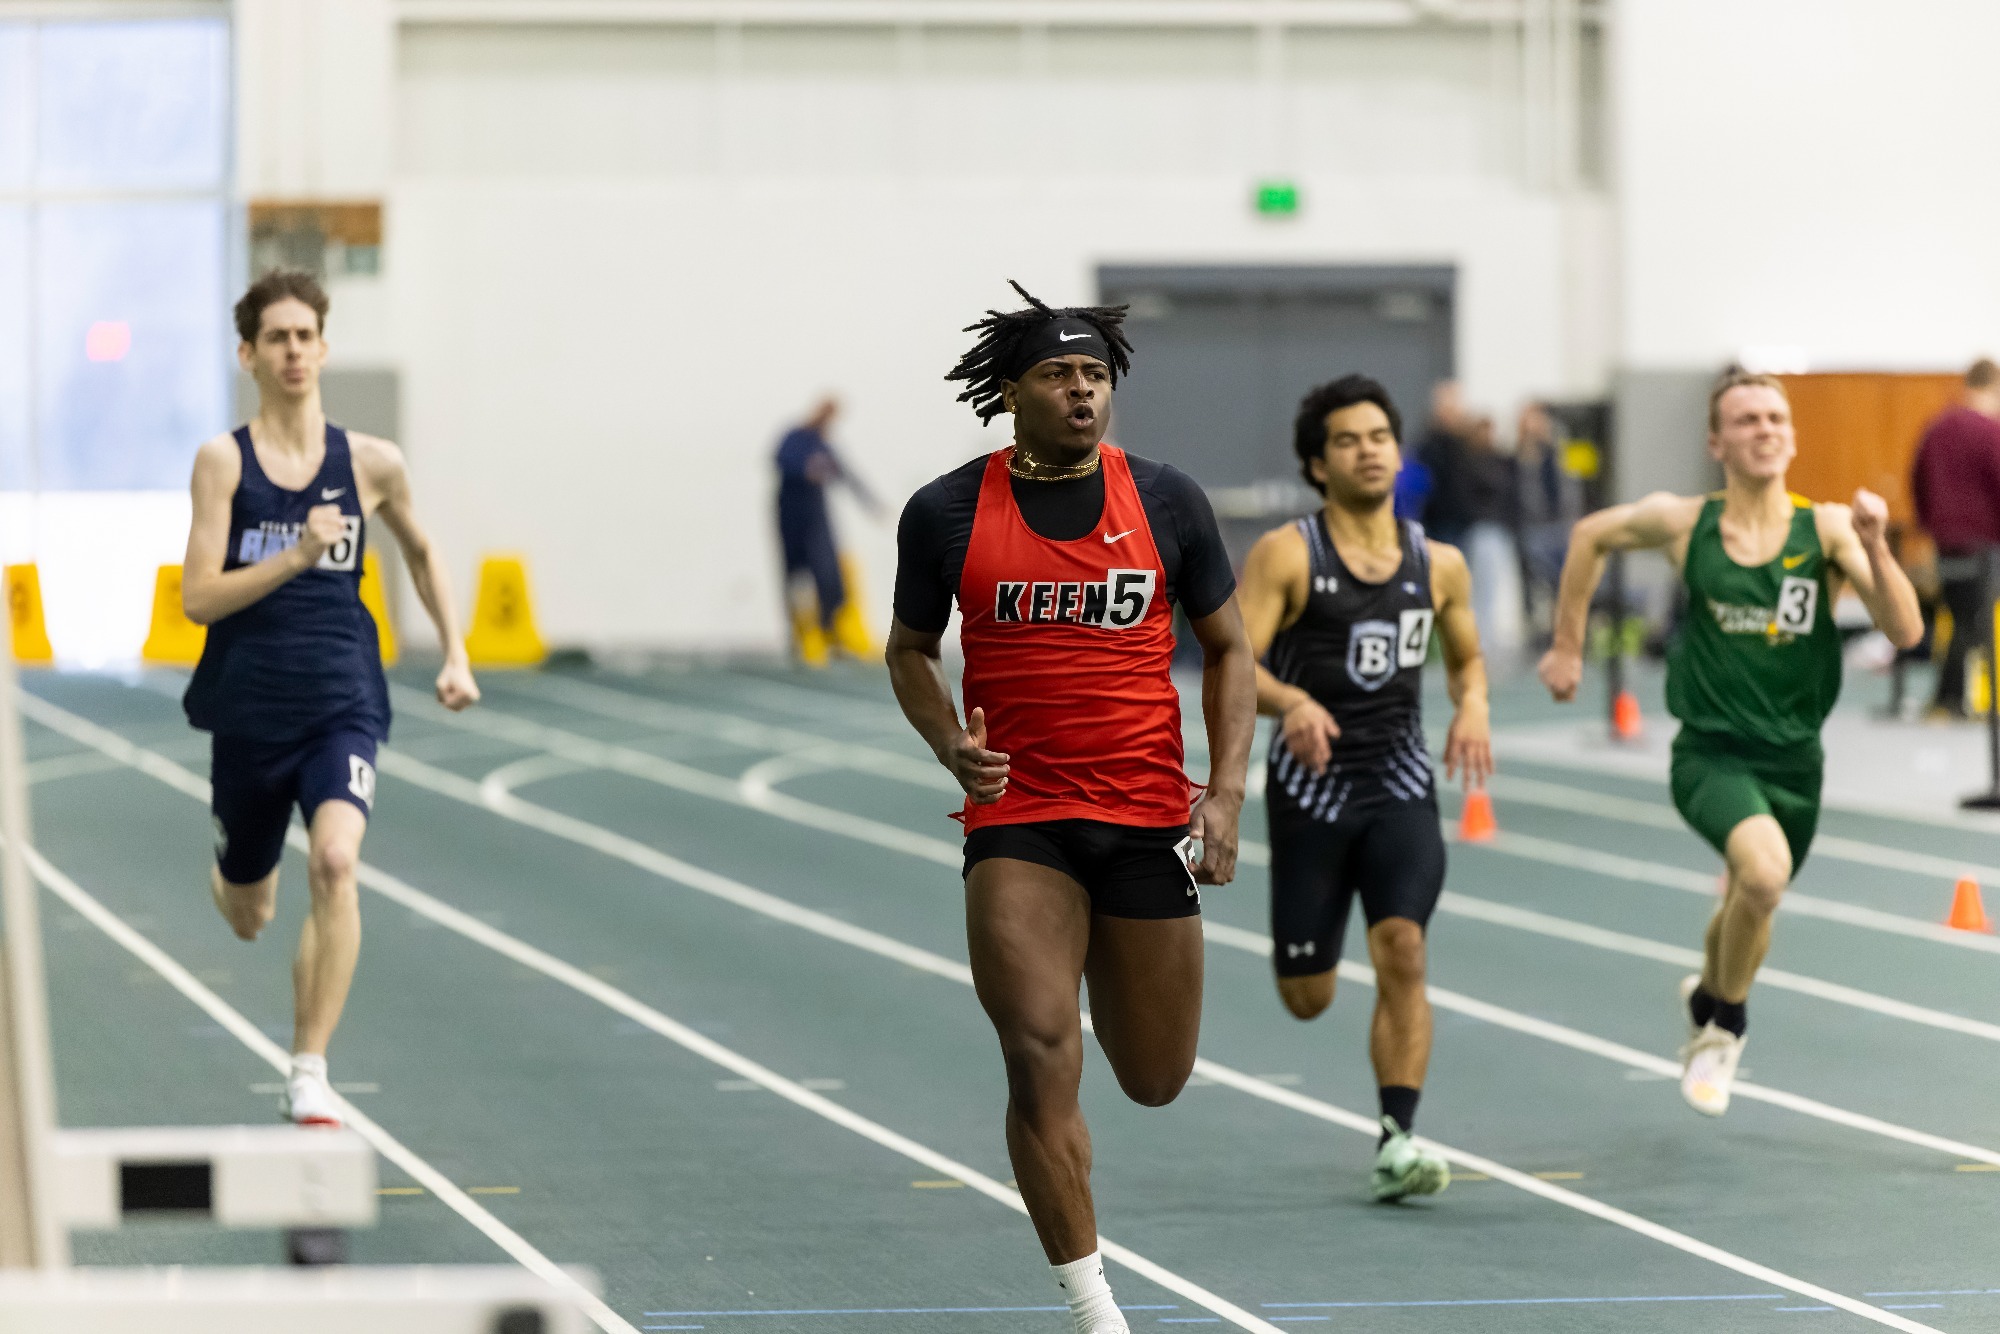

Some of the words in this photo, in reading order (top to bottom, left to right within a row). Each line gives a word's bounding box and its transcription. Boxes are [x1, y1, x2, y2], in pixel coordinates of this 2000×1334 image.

[1109, 573, 1147, 626] 5
[1783, 585, 1809, 625] 3
[1357, 635, 1389, 675] B
[1406, 616, 1426, 657] 4
